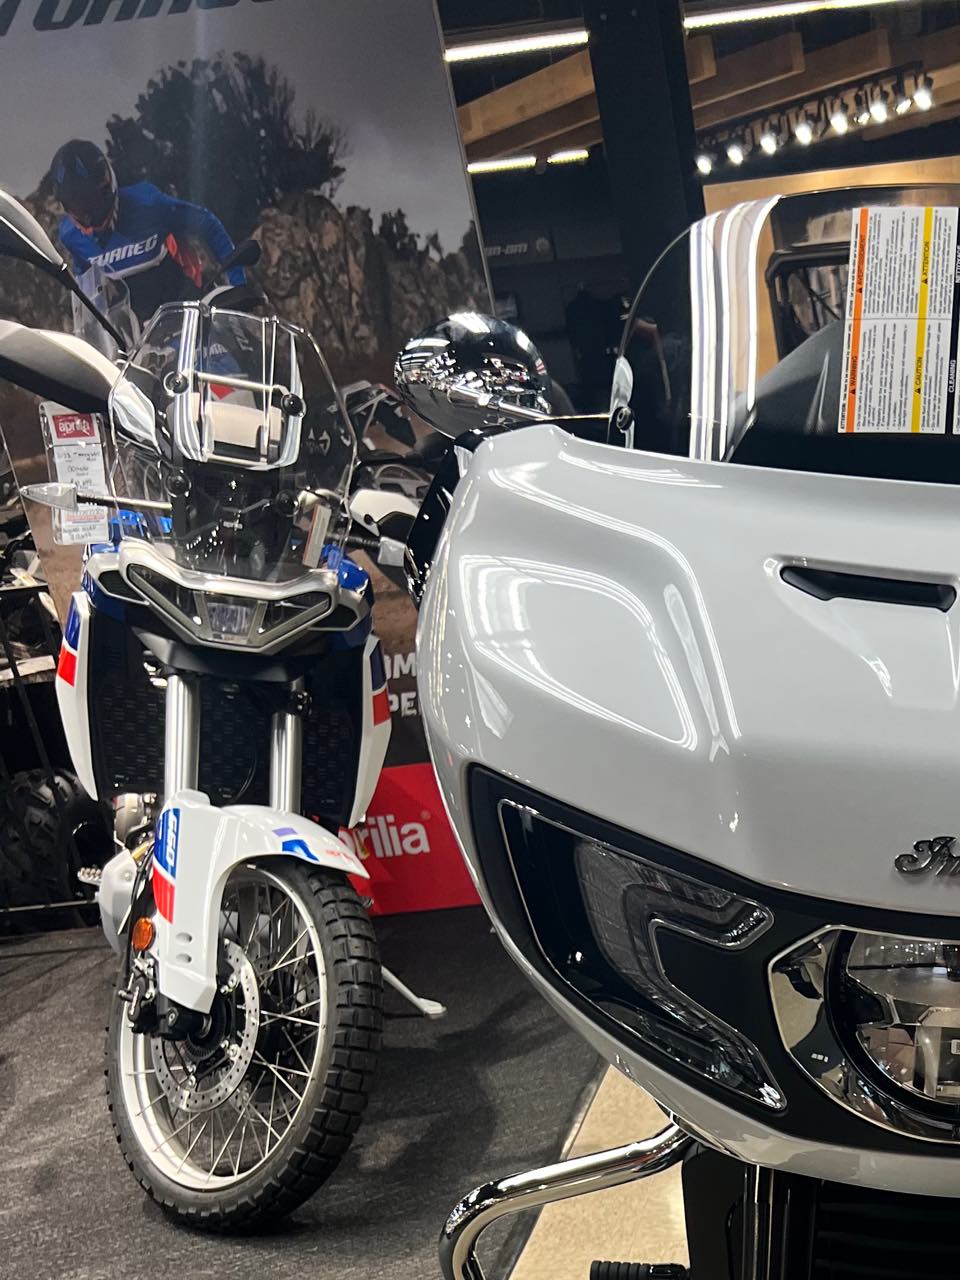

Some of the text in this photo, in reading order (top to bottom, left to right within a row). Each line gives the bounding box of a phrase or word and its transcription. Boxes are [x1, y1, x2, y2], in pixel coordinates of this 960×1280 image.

[849, 355, 858, 387] WARNING
[914, 356, 923, 386] CAUTION
[948, 359, 957, 393] CLEANING
